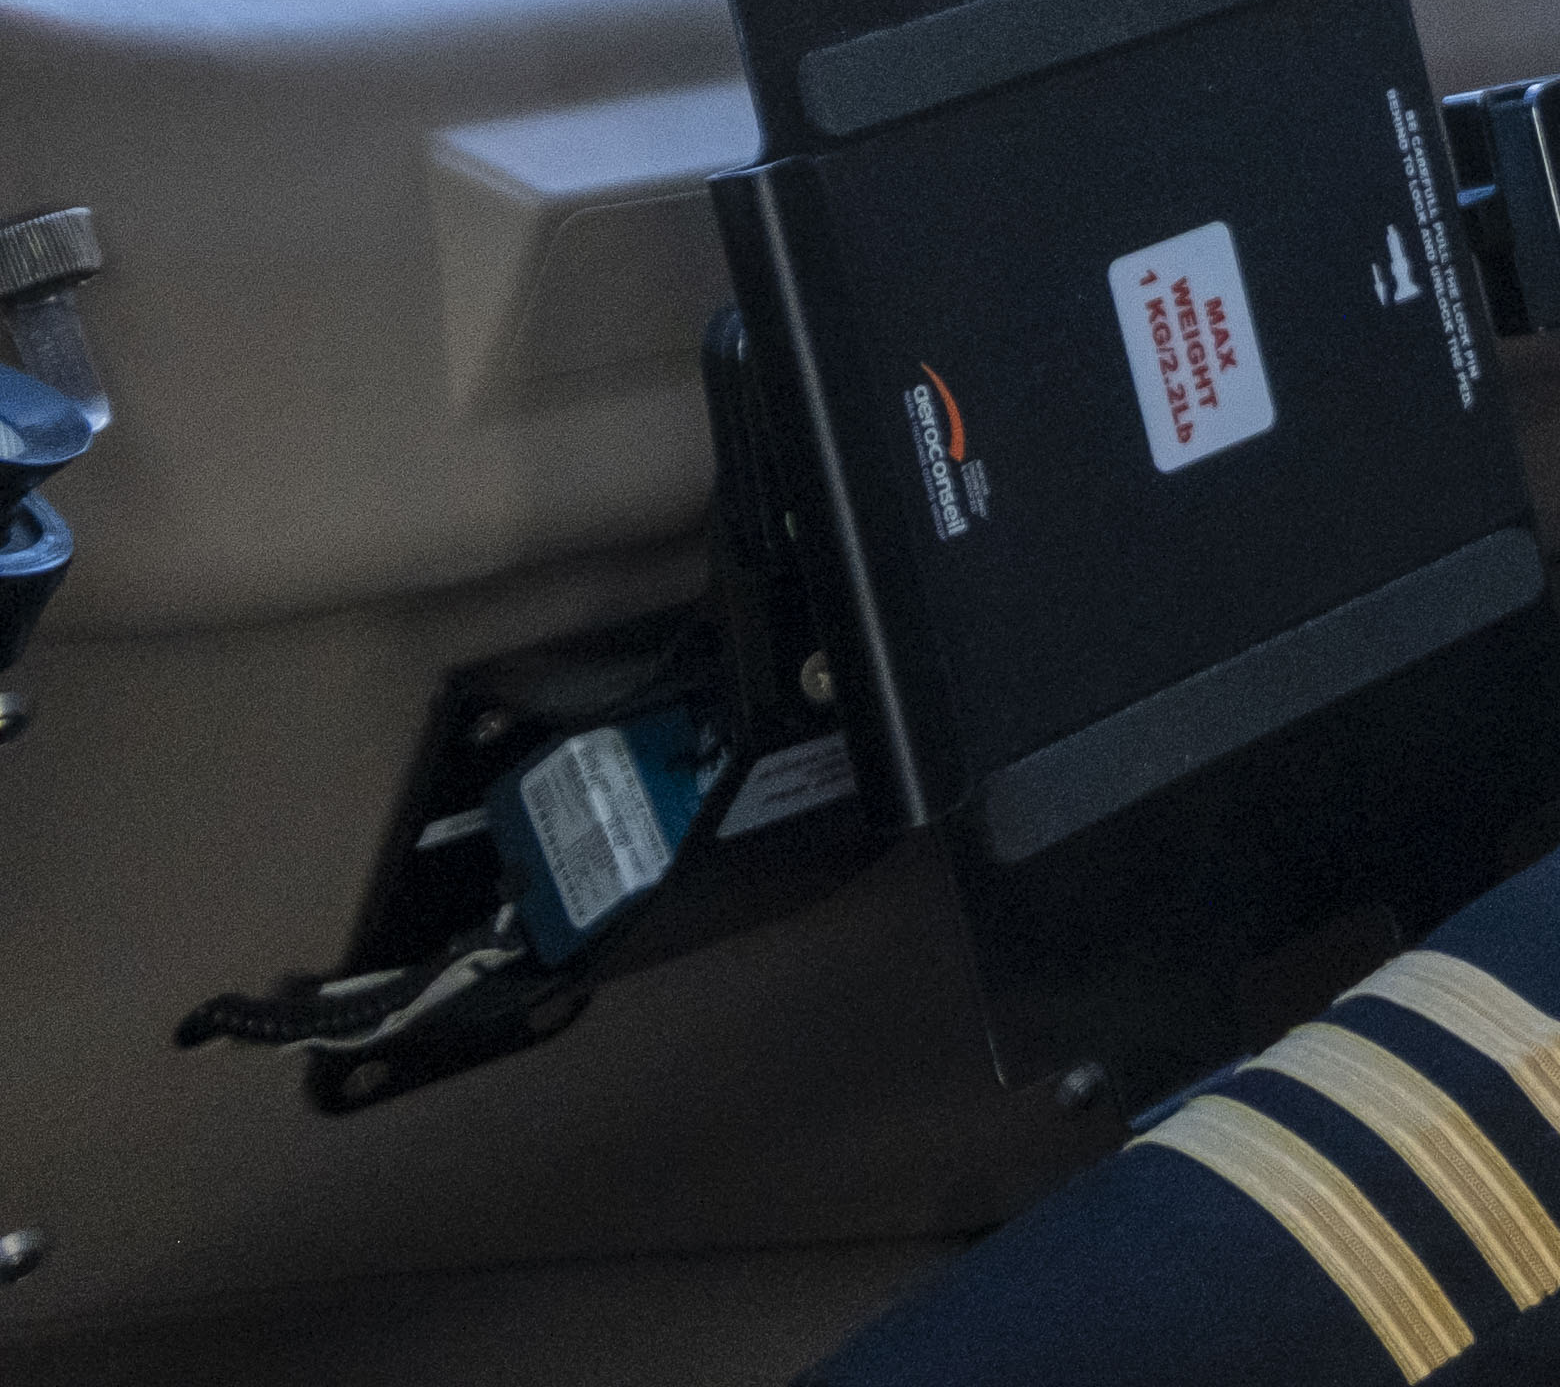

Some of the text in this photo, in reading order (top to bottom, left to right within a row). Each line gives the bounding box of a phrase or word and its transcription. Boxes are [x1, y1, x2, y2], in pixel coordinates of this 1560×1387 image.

[1403, 154, 1414, 177] TO
[1408, 179, 1427, 226] LOCK
[1420, 228, 1436, 262] AND
[1140, 270, 1159, 286] 1
[1430, 265, 1454, 333] UNLOCK
[1171, 277, 1218, 408] WEIGHT
[1204, 296, 1238, 372] MAX
[1448, 336, 1463, 369] THE
[1452, 302, 1470, 348] LOCK
[1463, 349, 1480, 379] PIN
[914, 385, 968, 536] aeroconseil
